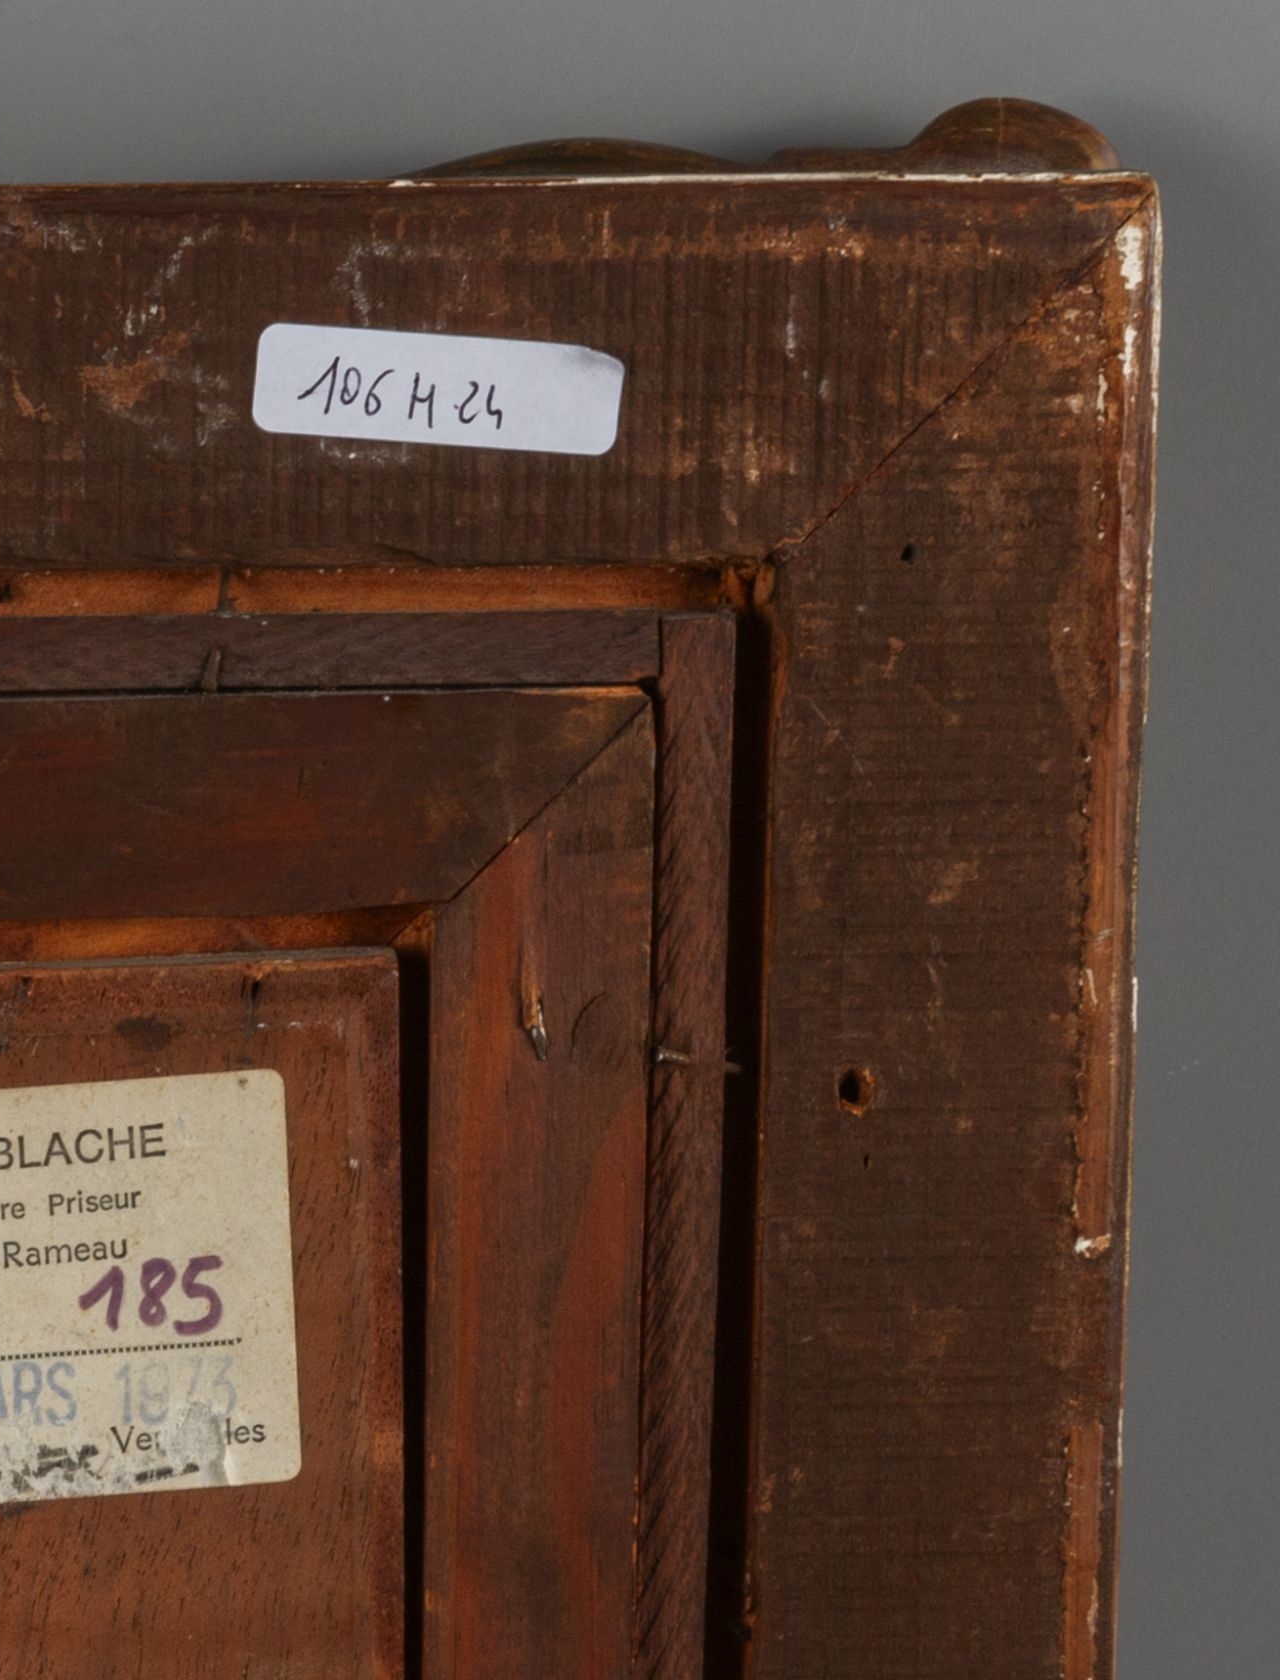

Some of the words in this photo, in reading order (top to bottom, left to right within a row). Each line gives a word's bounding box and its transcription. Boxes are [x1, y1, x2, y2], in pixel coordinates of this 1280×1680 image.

[297, 356, 396, 416] 106
[453, 380, 504, 430] 24
[48, 1189, 141, 1216] Priseur
[2, 1238, 128, 1268] Rameau
[78, 1254, 224, 1335] 185
